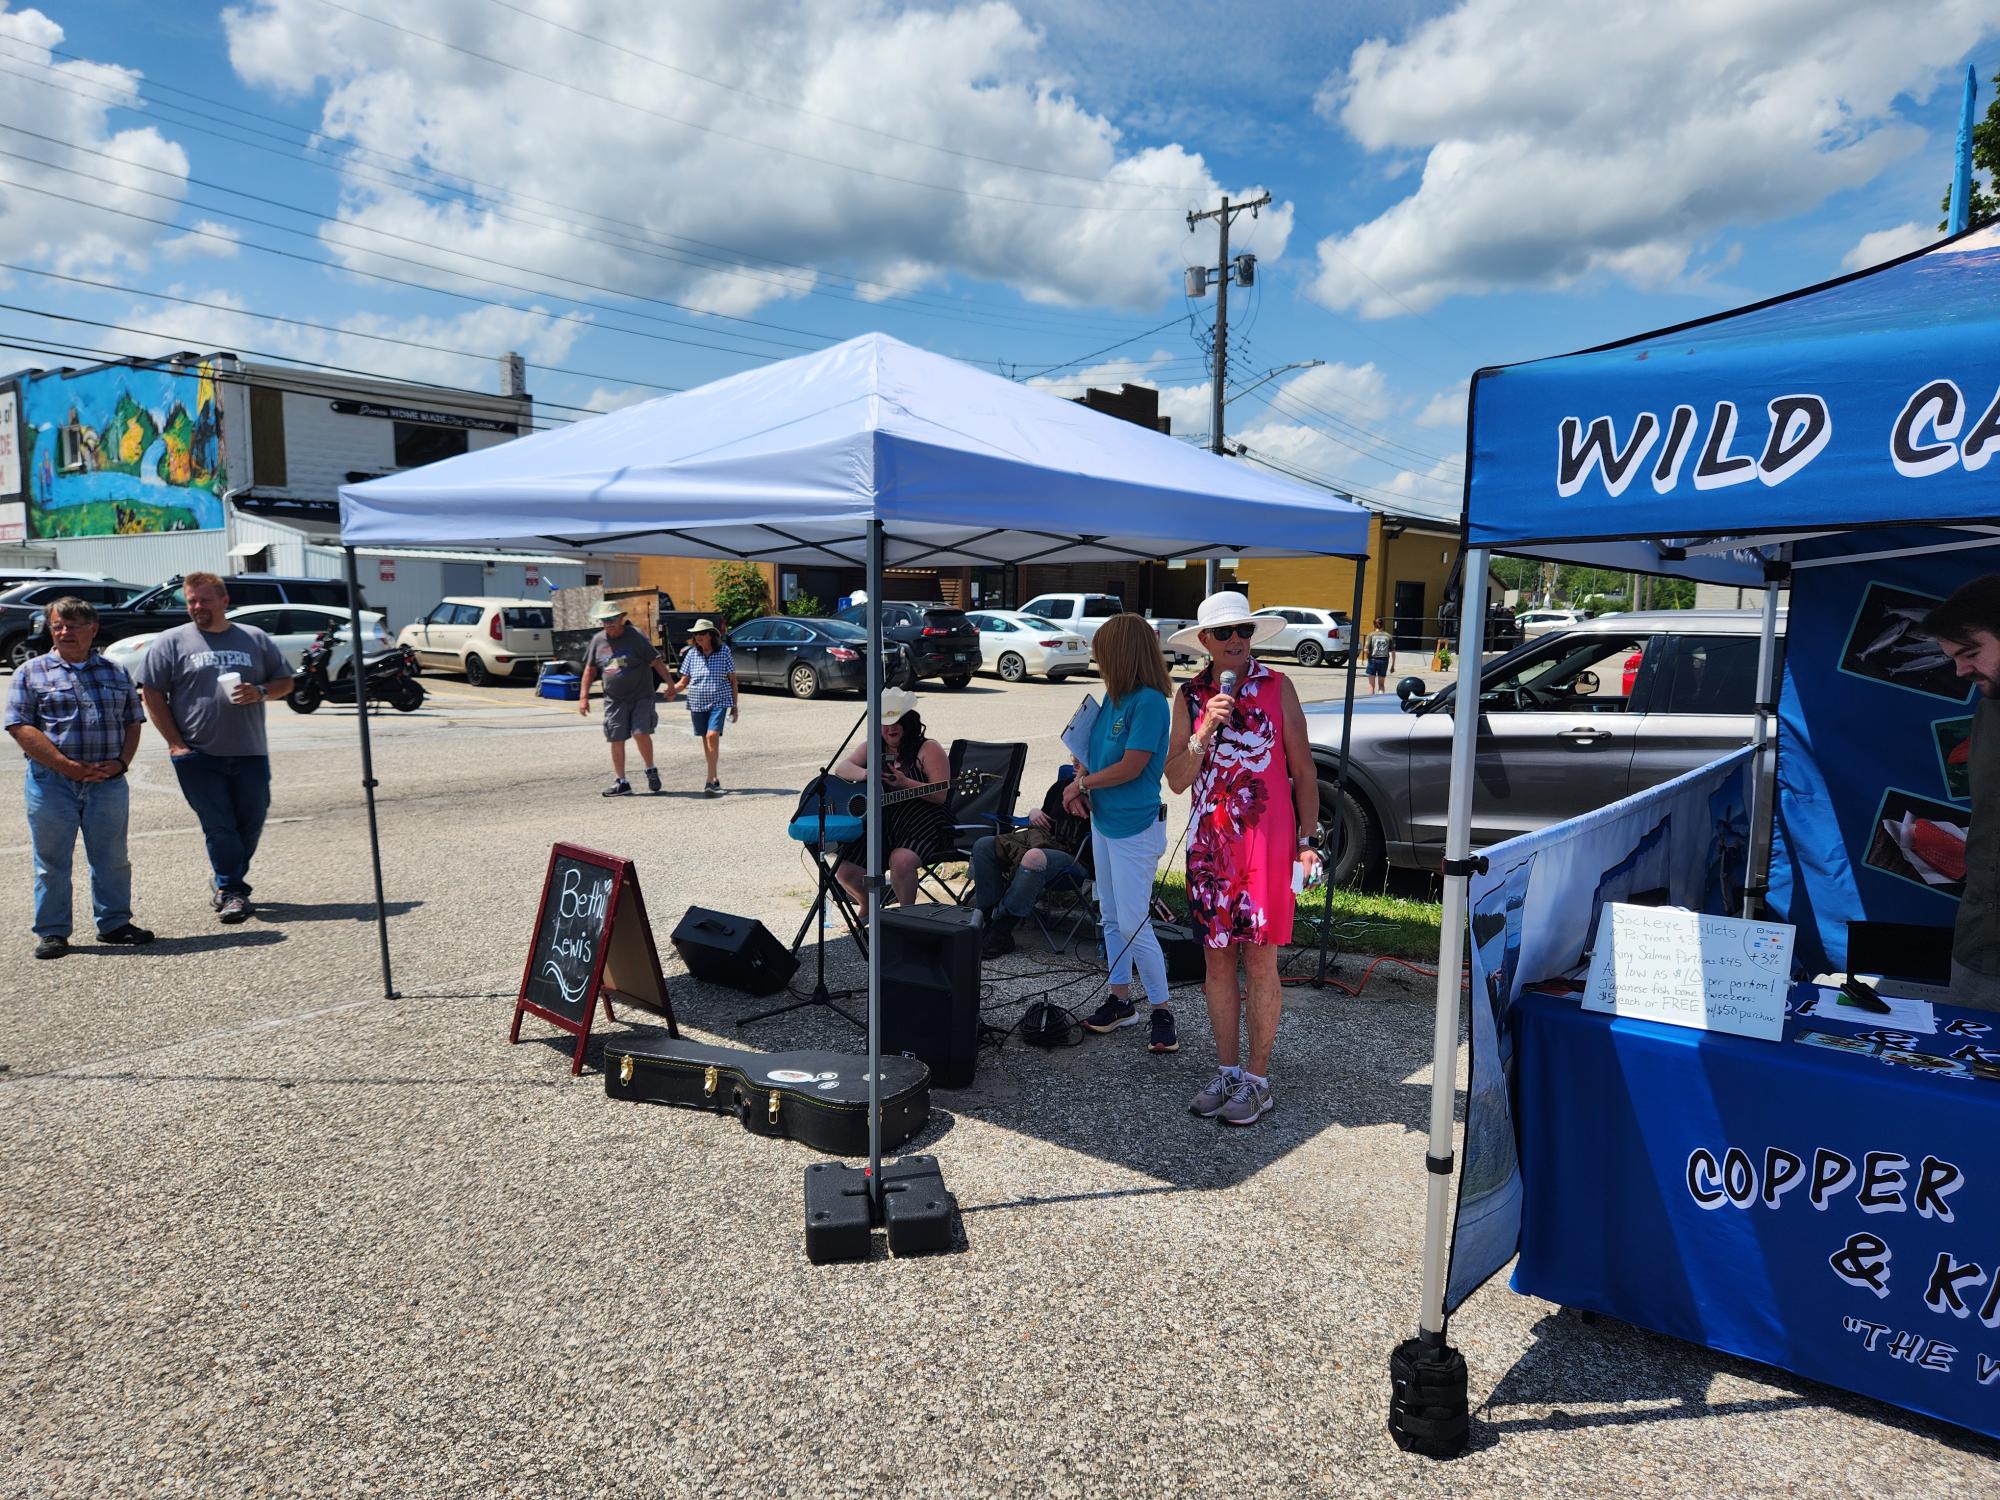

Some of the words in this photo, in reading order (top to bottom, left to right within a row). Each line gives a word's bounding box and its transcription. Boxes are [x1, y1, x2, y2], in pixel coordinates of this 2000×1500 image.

[390, 409, 419, 420] HOME
[420, 412, 447, 424] MADE
[1557, 394, 1832, 497] WILD
[190, 651, 253, 668] WESTERN
[1614, 910, 1683, 935] Sockeye
[1691, 919, 1737, 939] Fillets
[551, 917, 592, 962] Lewis
[1639, 945, 1671, 961] Salmon
[1719, 957, 1742, 968] $45
[1599, 979, 1648, 994] Japanese
[1708, 978, 1725, 992] per
[1618, 996, 1640, 1006] each
[1645, 1000, 1657, 1008] or
[1662, 997, 1700, 1012] FREE
[1687, 1146, 1965, 1223] COPPER
[1829, 1232, 1892, 1299] &
